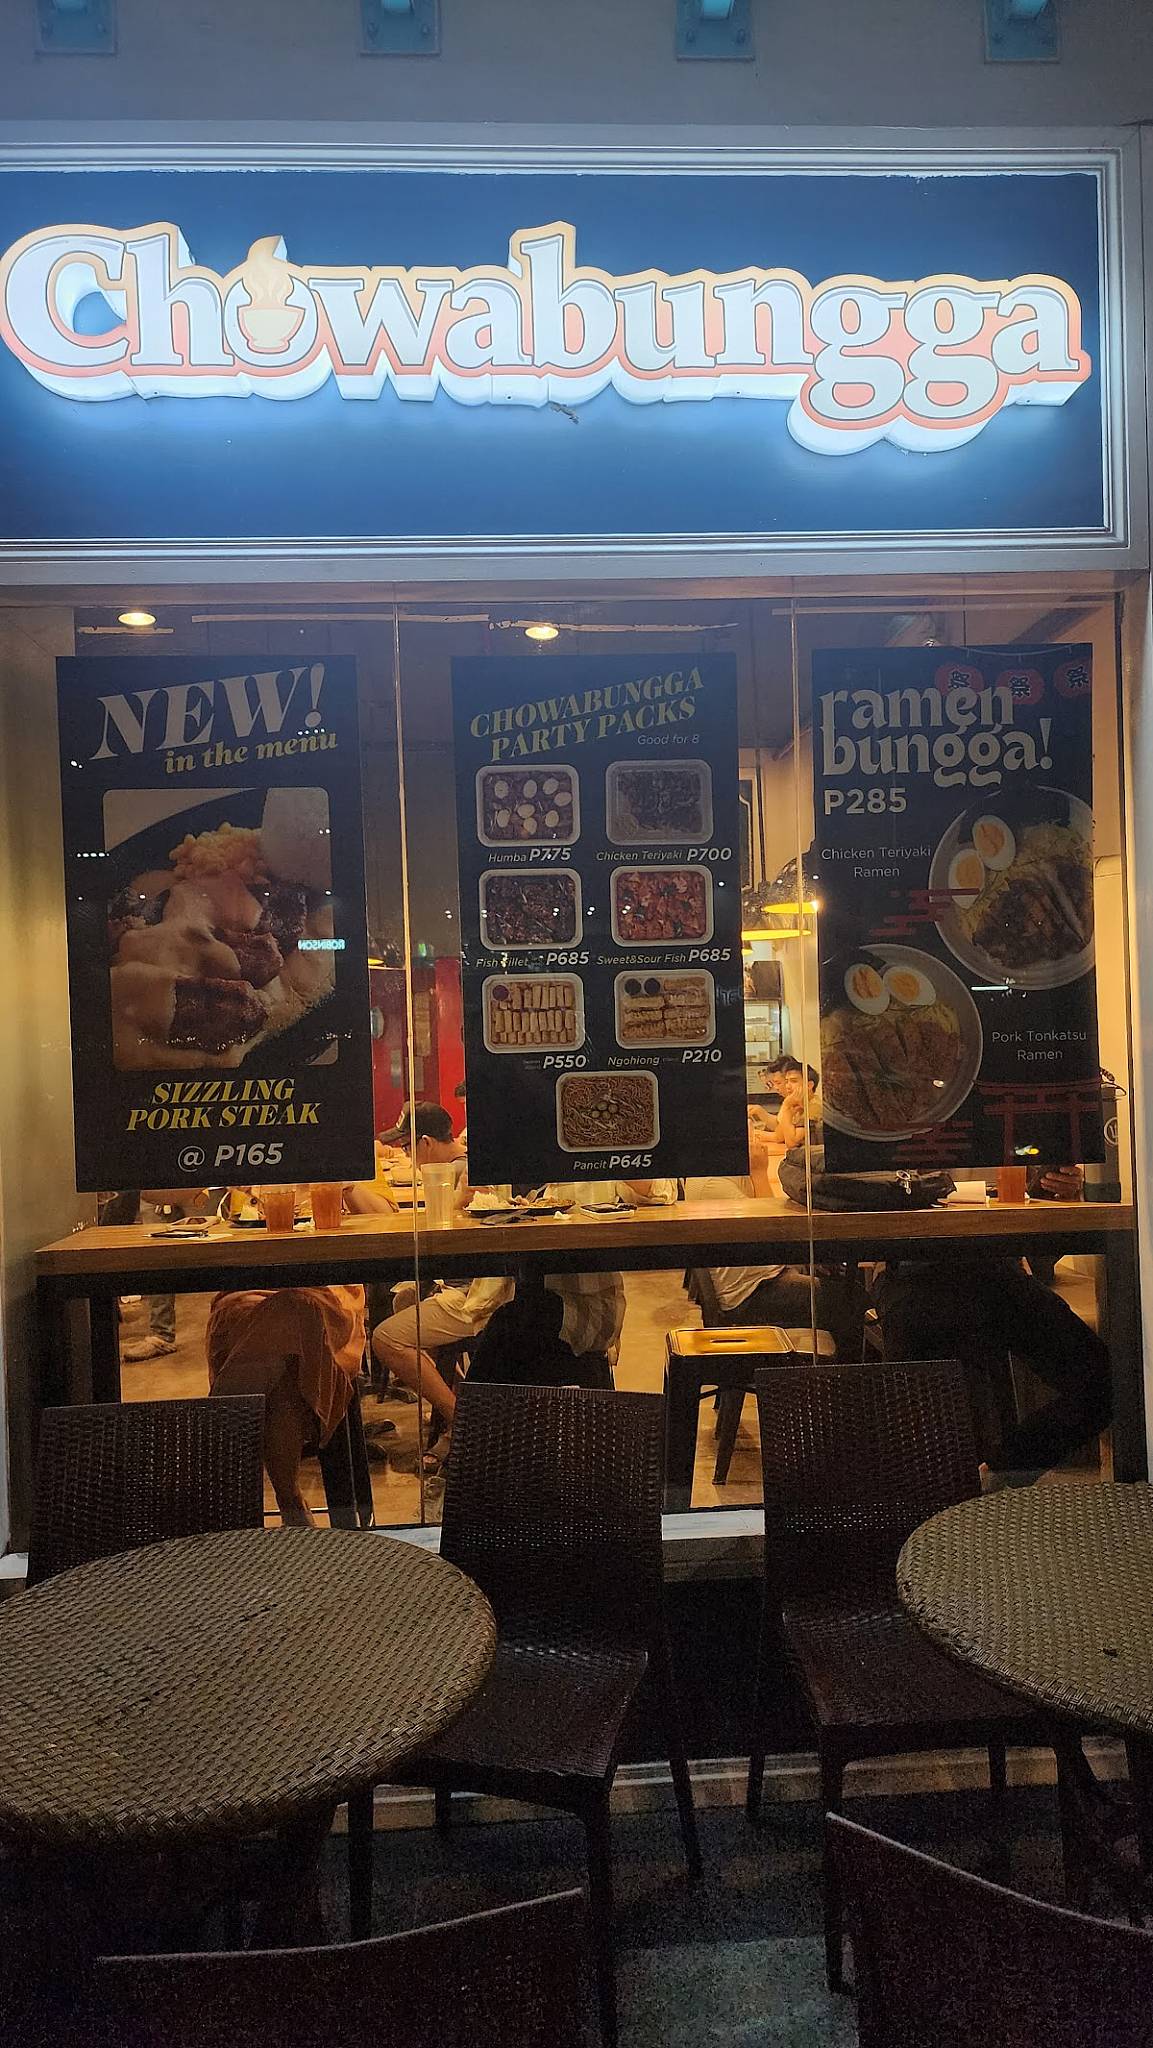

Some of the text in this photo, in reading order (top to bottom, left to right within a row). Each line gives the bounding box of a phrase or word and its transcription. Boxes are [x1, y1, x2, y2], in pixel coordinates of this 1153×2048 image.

[2, 225, 1086, 426] Chowabungga
[90, 663, 325, 760] NEW!
[470, 667, 704, 738] CHOWABUNGGA
[819, 686, 1015, 730] ramen
[491, 696, 696, 762] PARTY PACKS
[637, 733, 700, 745] Good for 8
[165, 732, 339, 774] in the menu
[820, 718, 1053, 788] bungga!
[824, 787, 907, 815] P285
[488, 847, 571, 863] Humba P775
[596, 847, 732, 862] Chicken Teriyaki P700
[821, 845, 931, 861] Chicken Teriyaki
[854, 867, 900, 878] Ramen
[476, 958, 498, 968] Fish
[546, 951, 589, 966] P685
[597, 948, 731, 966] Sweet&Sour Fish P685
[992, 1030, 1087, 1042] Pork Tonkatsu
[543, 1055, 587, 1069] P550
[608, 1049, 722, 1067] Ngohiong P210
[1017, 1049, 1063, 1061] Ramen
[151, 1078, 295, 1104] SIZZLING
[126, 1102, 322, 1131] PORK STEAK
[177, 1142, 284, 1172] @ P165
[573, 1154, 652, 1171] Pancit P645
